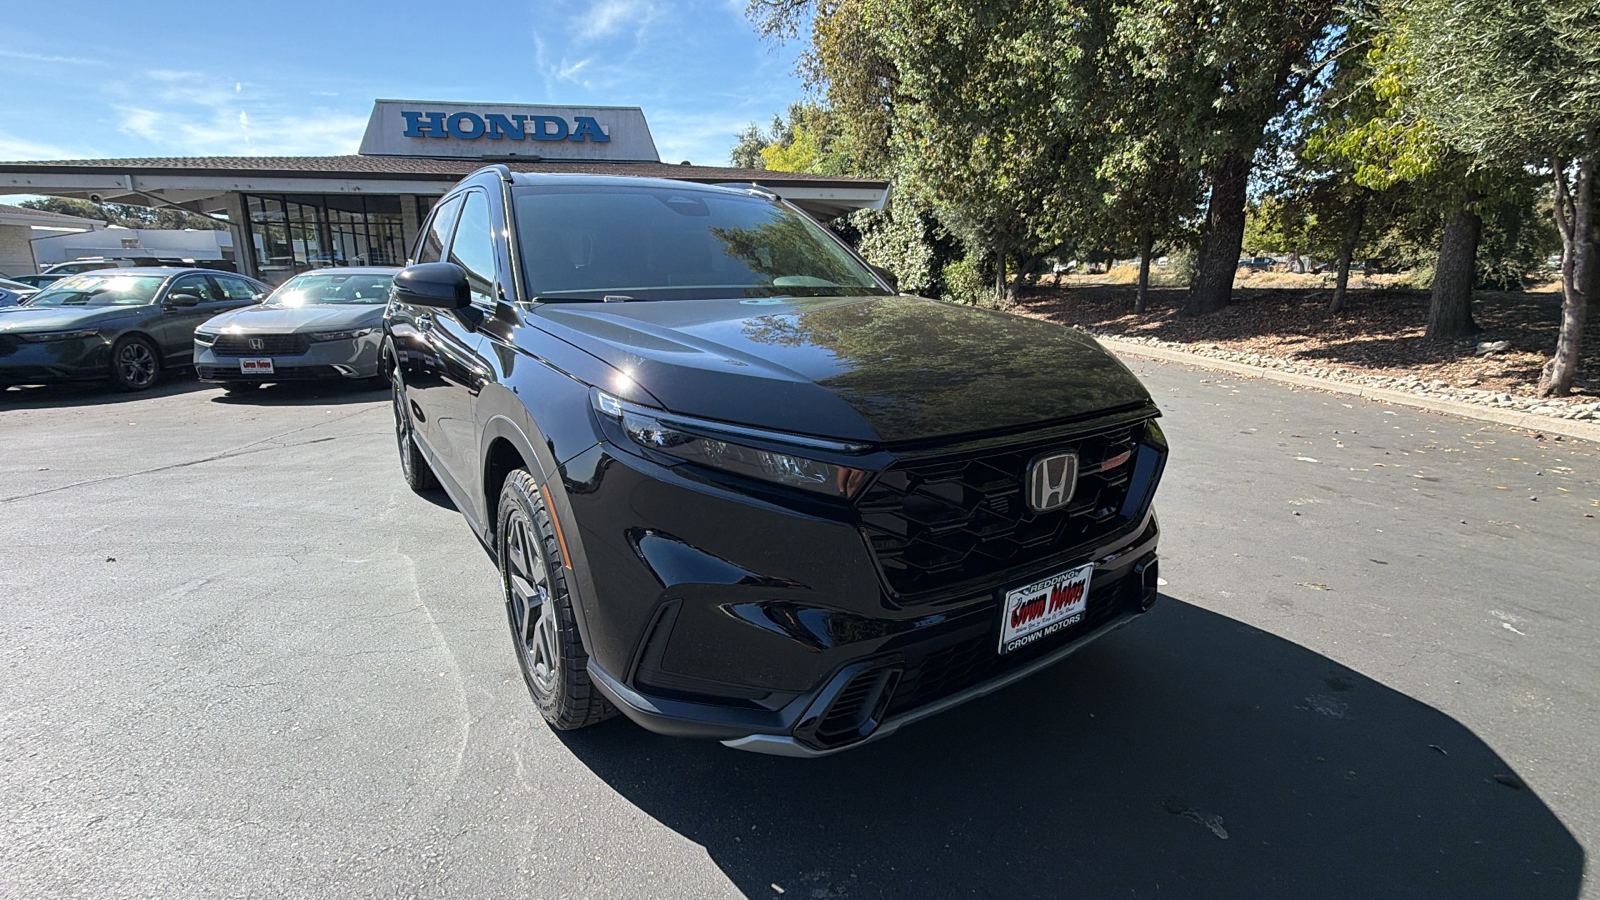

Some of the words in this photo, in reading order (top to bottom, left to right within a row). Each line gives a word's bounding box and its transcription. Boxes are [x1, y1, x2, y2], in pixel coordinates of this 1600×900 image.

[401, 111, 611, 142] HONDA
[1030, 571, 1075, 593] REDDING
[1010, 593, 1047, 629] Crown
[1047, 578, 1086, 615] Motors
[1008, 630, 1043, 652] CROWN
[1044, 614, 1081, 635] MOTORS
